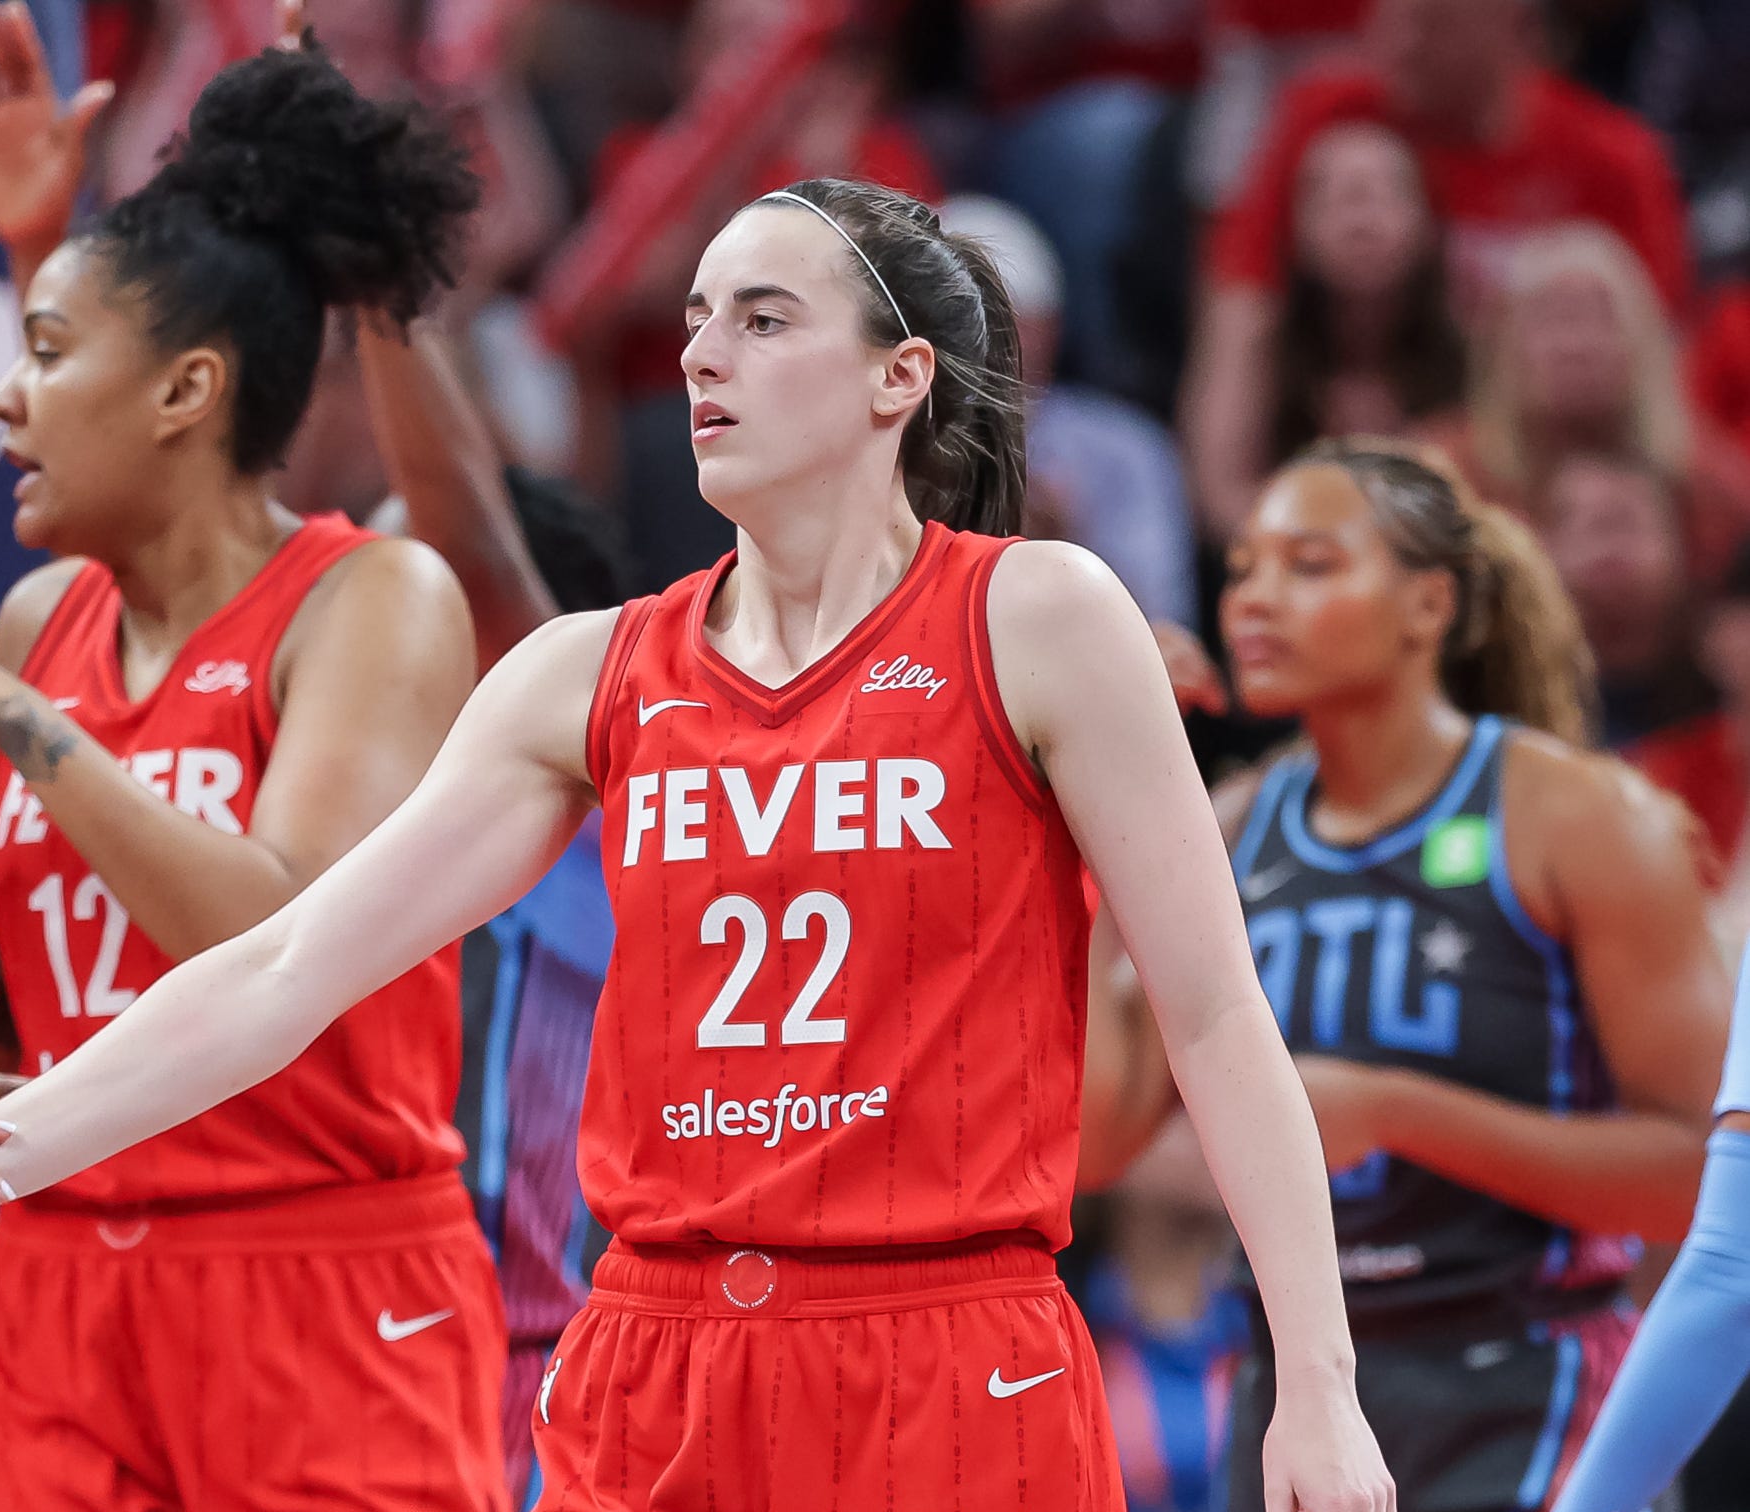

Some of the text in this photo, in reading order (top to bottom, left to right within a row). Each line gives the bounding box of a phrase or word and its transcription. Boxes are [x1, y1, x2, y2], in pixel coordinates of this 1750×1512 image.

[860, 654, 948, 700] Lilly
[621, 757, 953, 868] FEVER
[28, 871, 139, 1018] 12
[696, 888, 851, 1050] 22
[661, 1084, 888, 1148] salesforce
[951, 1366, 961, 1419] 2020
[1015, 1401, 1025, 1468] CHOSE
